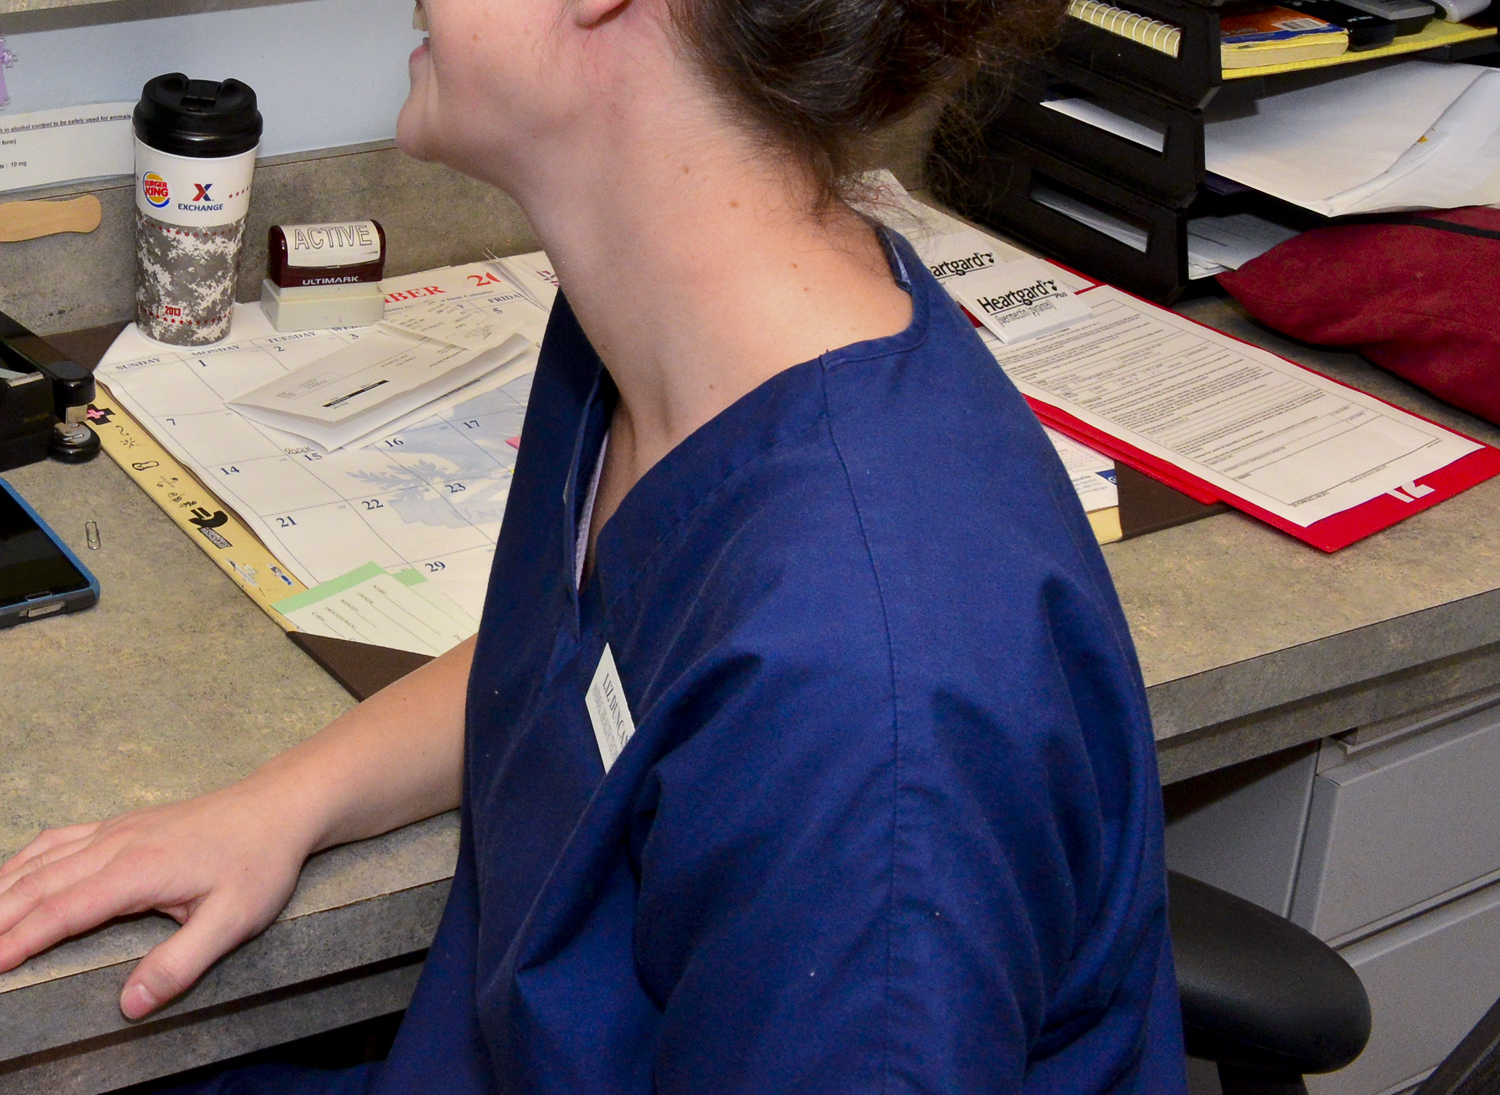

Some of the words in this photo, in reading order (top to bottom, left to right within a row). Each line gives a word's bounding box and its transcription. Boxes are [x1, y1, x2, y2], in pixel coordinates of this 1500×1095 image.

[144, 180, 168, 189] BURGER
[145, 187, 169, 197] KING
[178, 203, 223, 212] EXCHANGE
[294, 224, 373, 251] ACTIVE
[930, 252, 985, 277] artgard
[302, 276, 359, 286] ULTIMARK
[977, 279, 1049, 314] Heartgard
[164, 305, 182, 317] 2013
[198, 359, 207, 368] 1
[274, 345, 286, 353] 2
[493, 307, 503, 315] 5
[115, 357, 162, 371] SUNDAY
[191, 344, 241, 357] MONDAY
[267, 331, 315, 344] TUESDAY
[166, 418, 176, 426] 7
[220, 465, 240, 476] 14
[304, 452, 322, 462] 15
[384, 438, 404, 448] 16
[462, 419, 481, 430] 17
[276, 515, 298, 528] 21
[362, 499, 384, 511] 22
[445, 483, 466, 494] 23
[424, 561, 446, 573] 29
